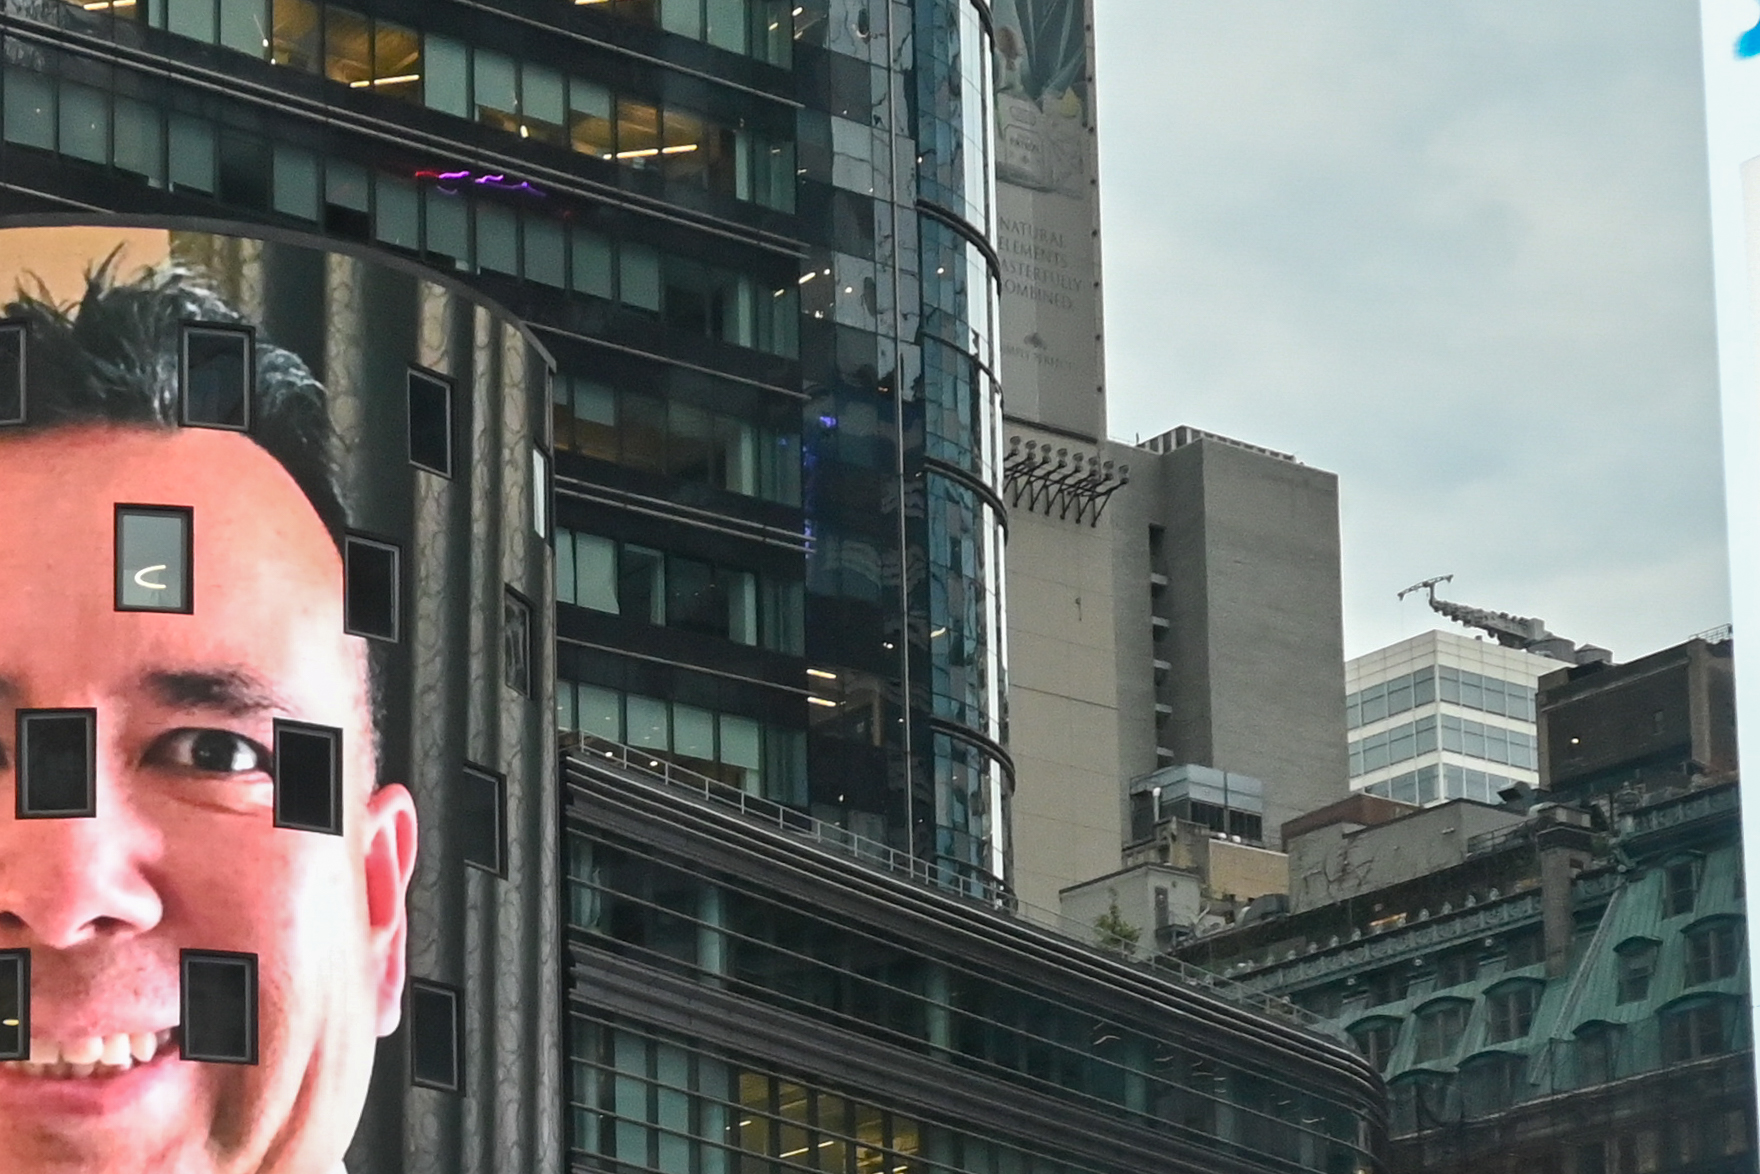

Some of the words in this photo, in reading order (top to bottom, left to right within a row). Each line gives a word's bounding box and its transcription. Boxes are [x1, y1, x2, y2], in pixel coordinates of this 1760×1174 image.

[999, 217, 1064, 249] NATURAL
[998, 236, 1069, 269] ELEMENTS
[1000, 258, 1083, 292] ASTERFULLY
